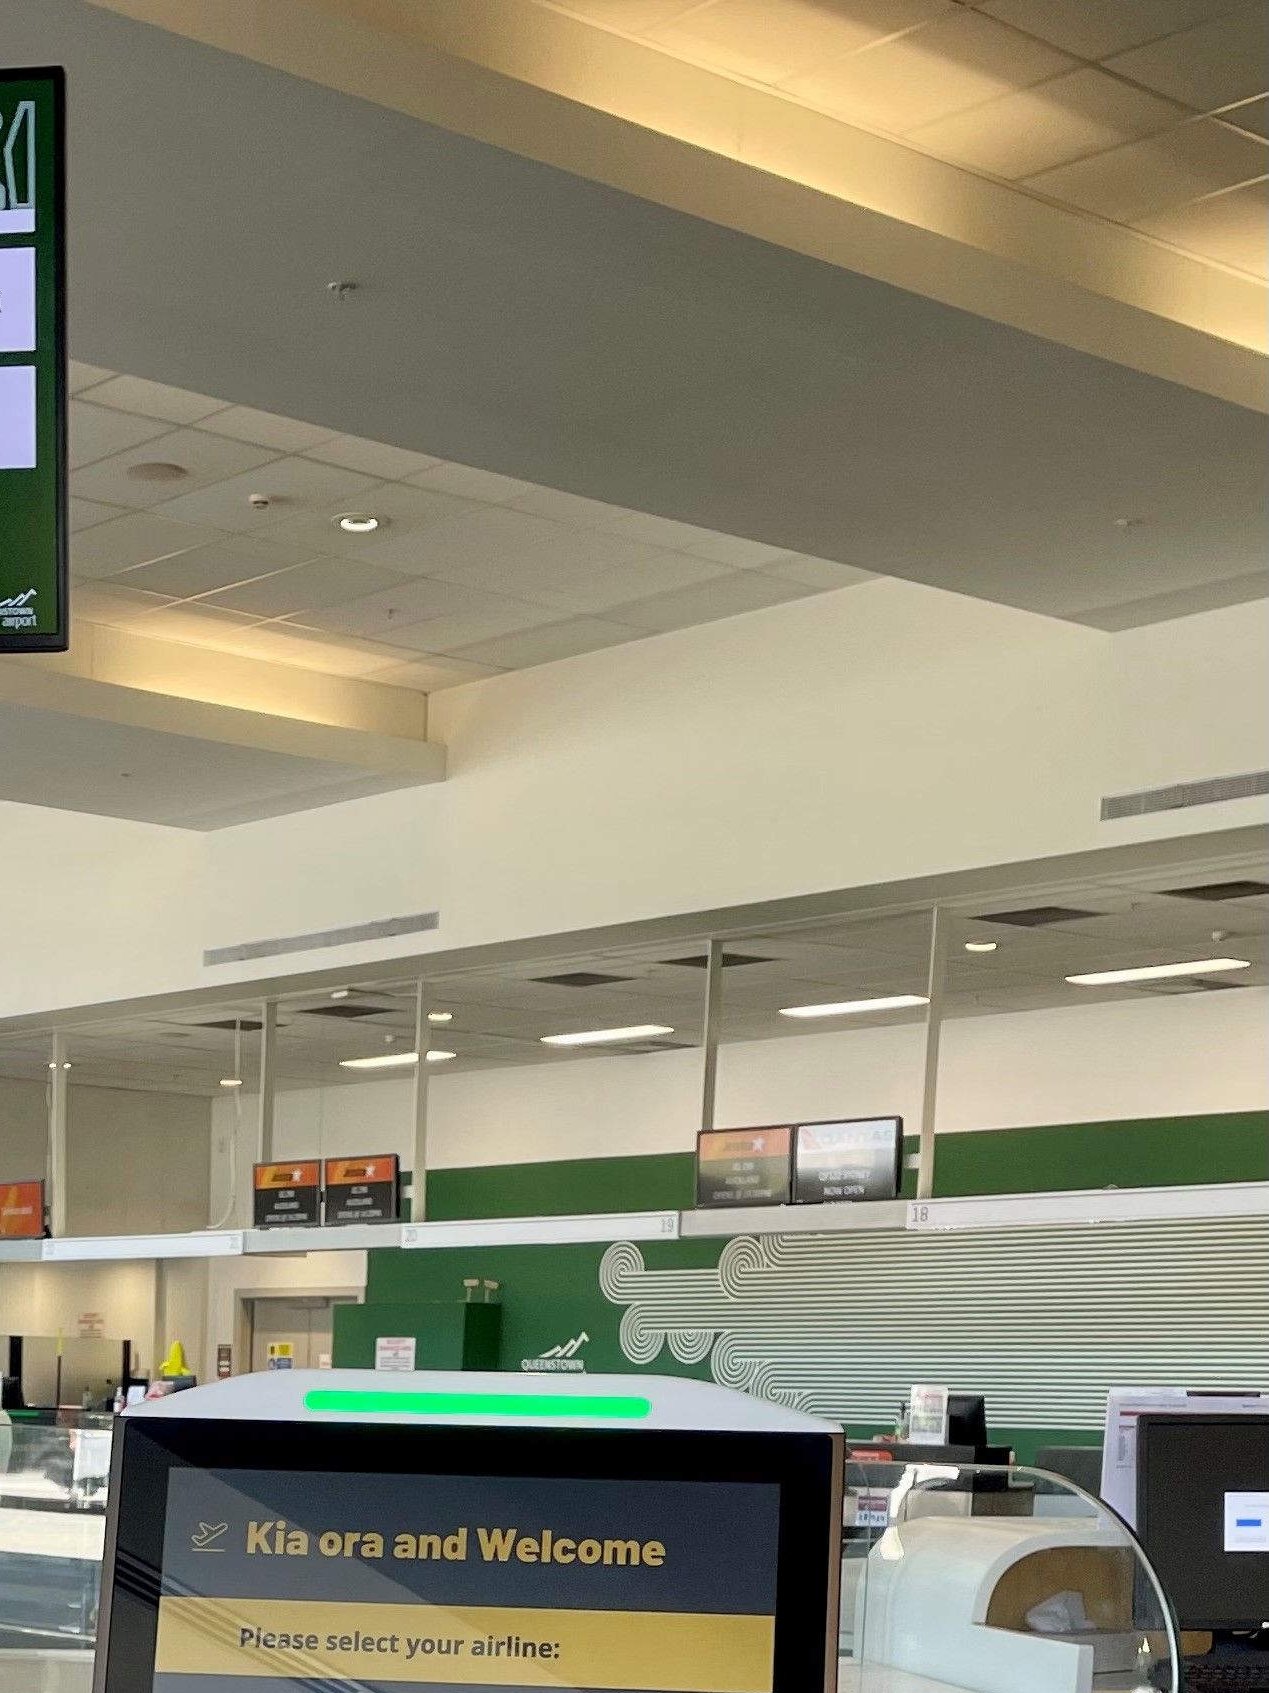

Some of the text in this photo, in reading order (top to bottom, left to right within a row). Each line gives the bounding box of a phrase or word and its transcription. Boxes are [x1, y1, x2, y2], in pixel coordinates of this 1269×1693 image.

[1, 615, 37, 630] airport
[911, 1206, 929, 1222] 18
[660, 1218, 675, 1233] 19
[521, 1359, 584, 1371] QUEENSTOWN
[246, 1520, 667, 1567] Kia ora and Welcome
[239, 1627, 560, 1660] Please select your airline:
